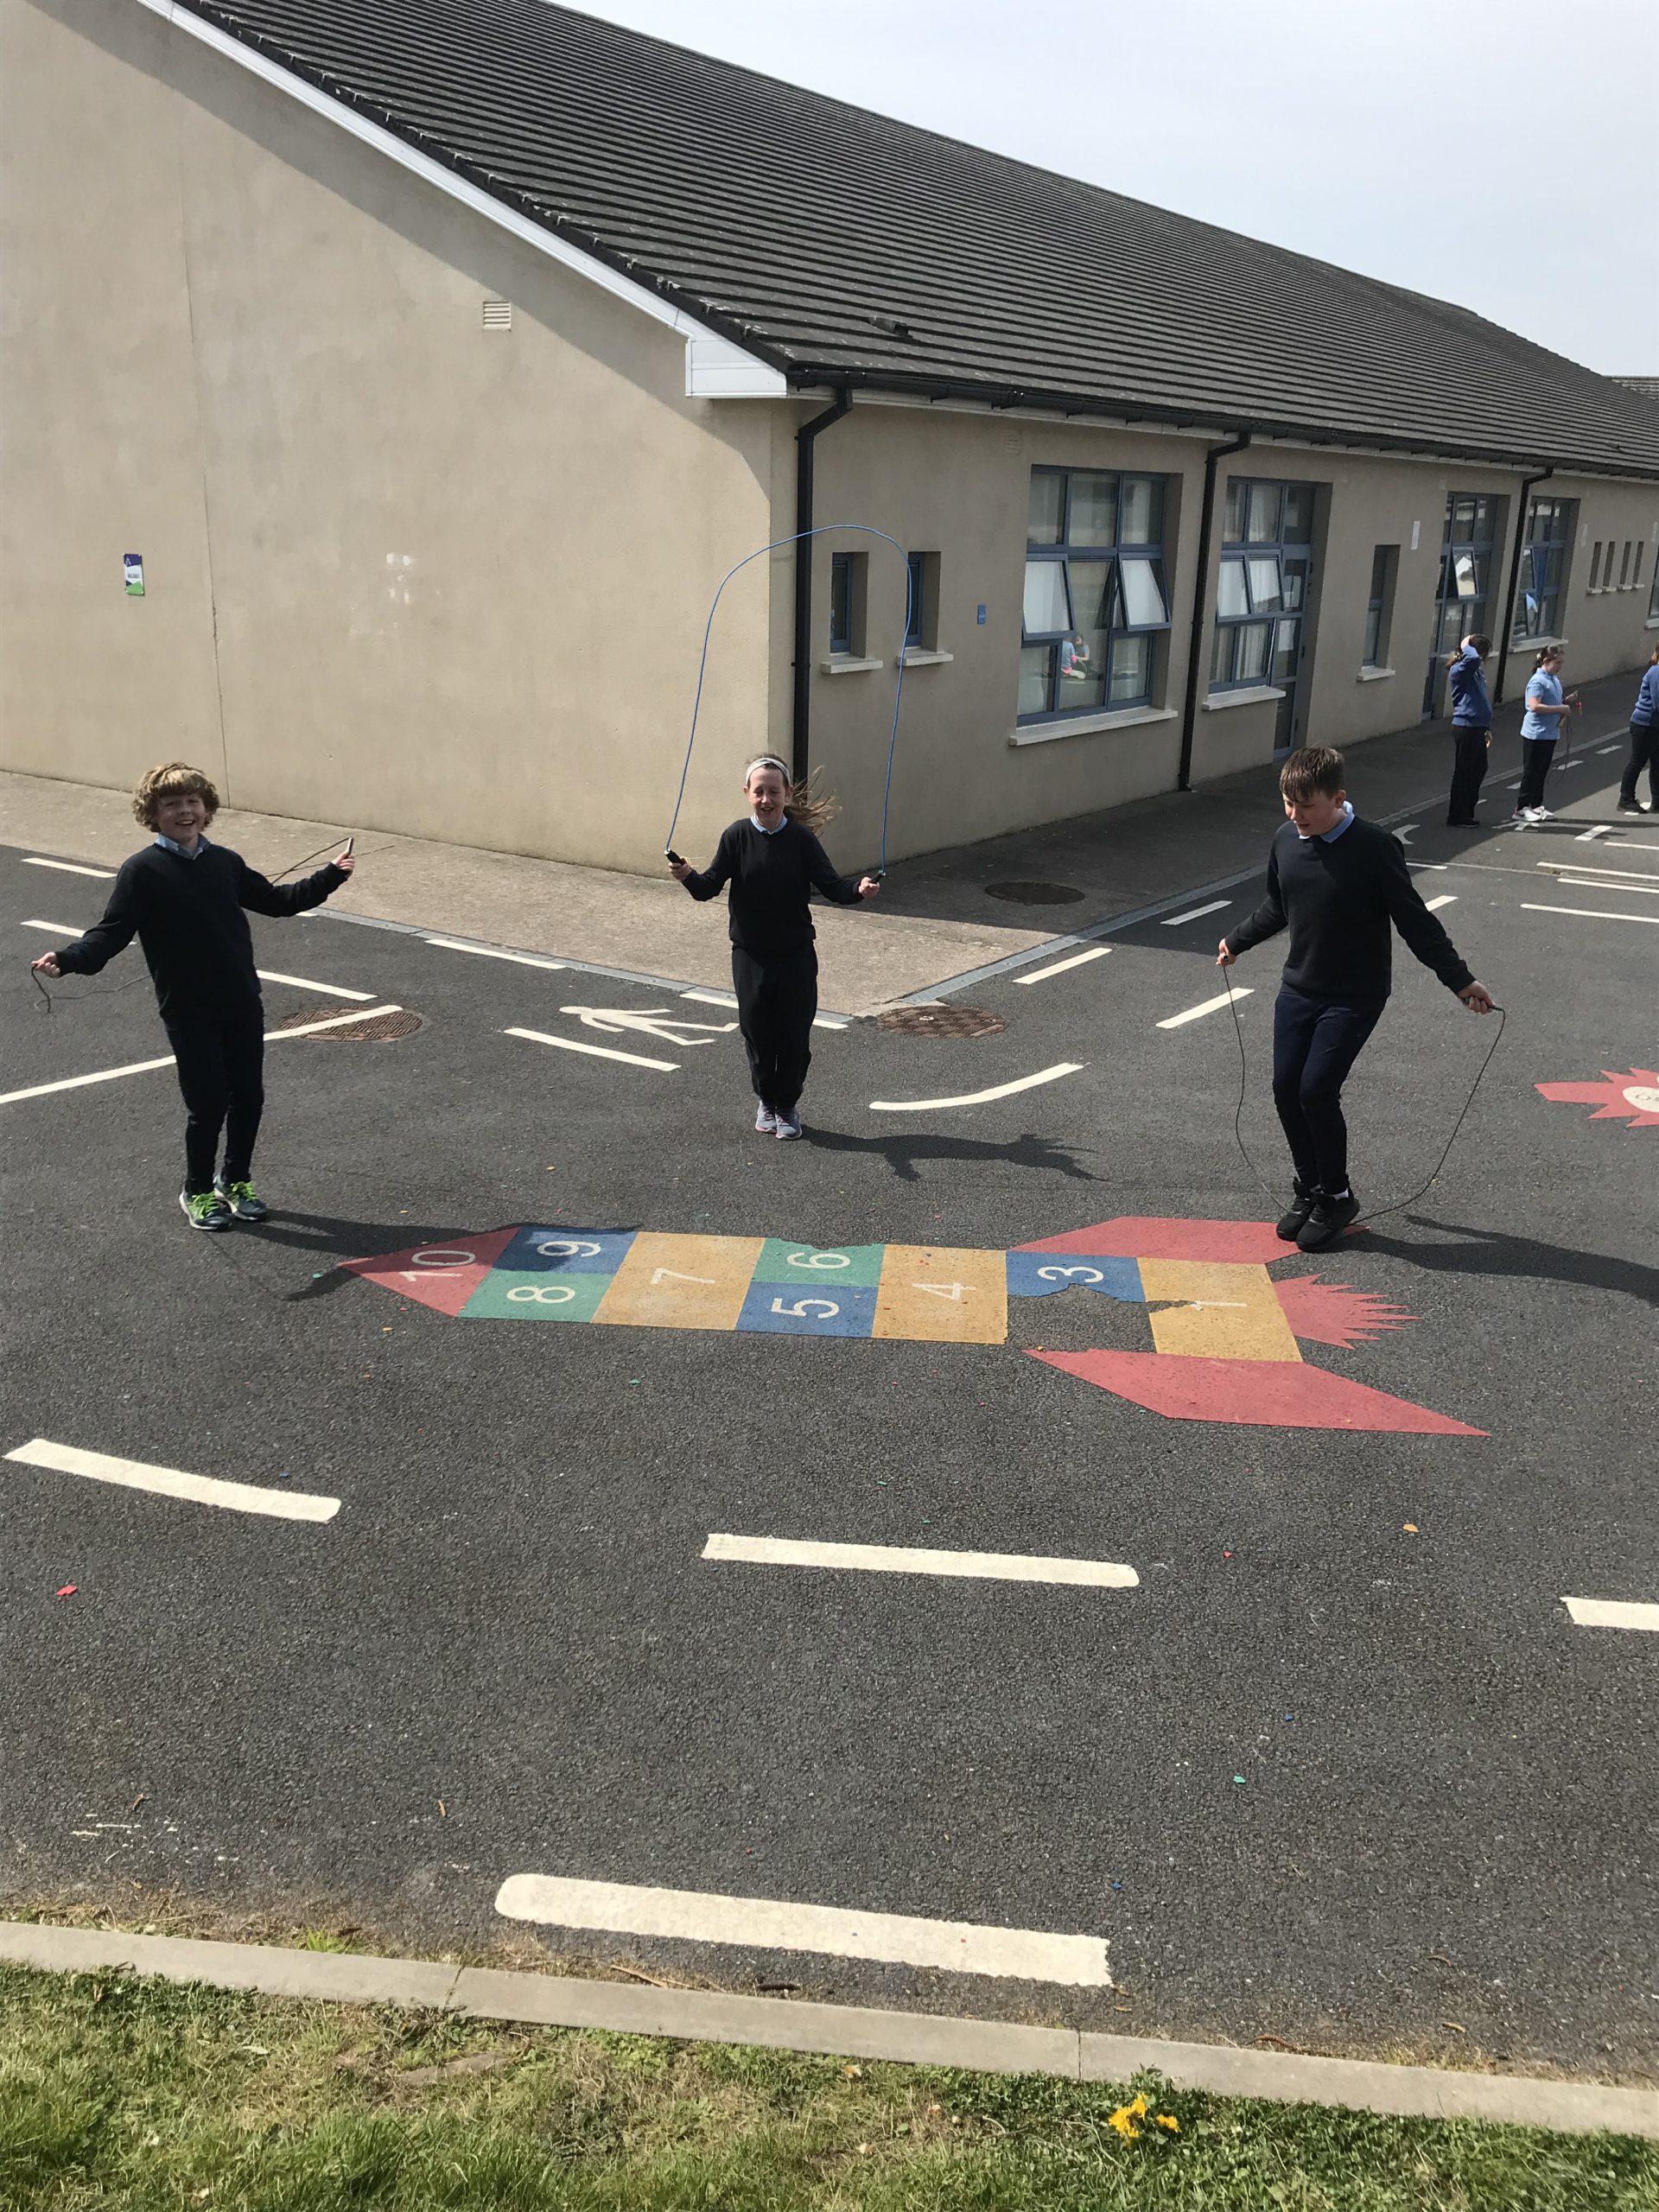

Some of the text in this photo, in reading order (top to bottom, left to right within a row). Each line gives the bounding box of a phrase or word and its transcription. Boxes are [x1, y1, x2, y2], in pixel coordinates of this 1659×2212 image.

[537, 1241, 601, 1257] 9
[398, 1249, 476, 1282] 10
[786, 1253, 851, 1269] 6
[650, 1267, 715, 1285] 7
[1037, 1266, 1104, 1283] 3
[506, 1286, 575, 1304] 8
[912, 1281, 976, 1300] 4
[771, 1298, 840, 1319] 5
[1189, 1300, 1247, 1312] 1
